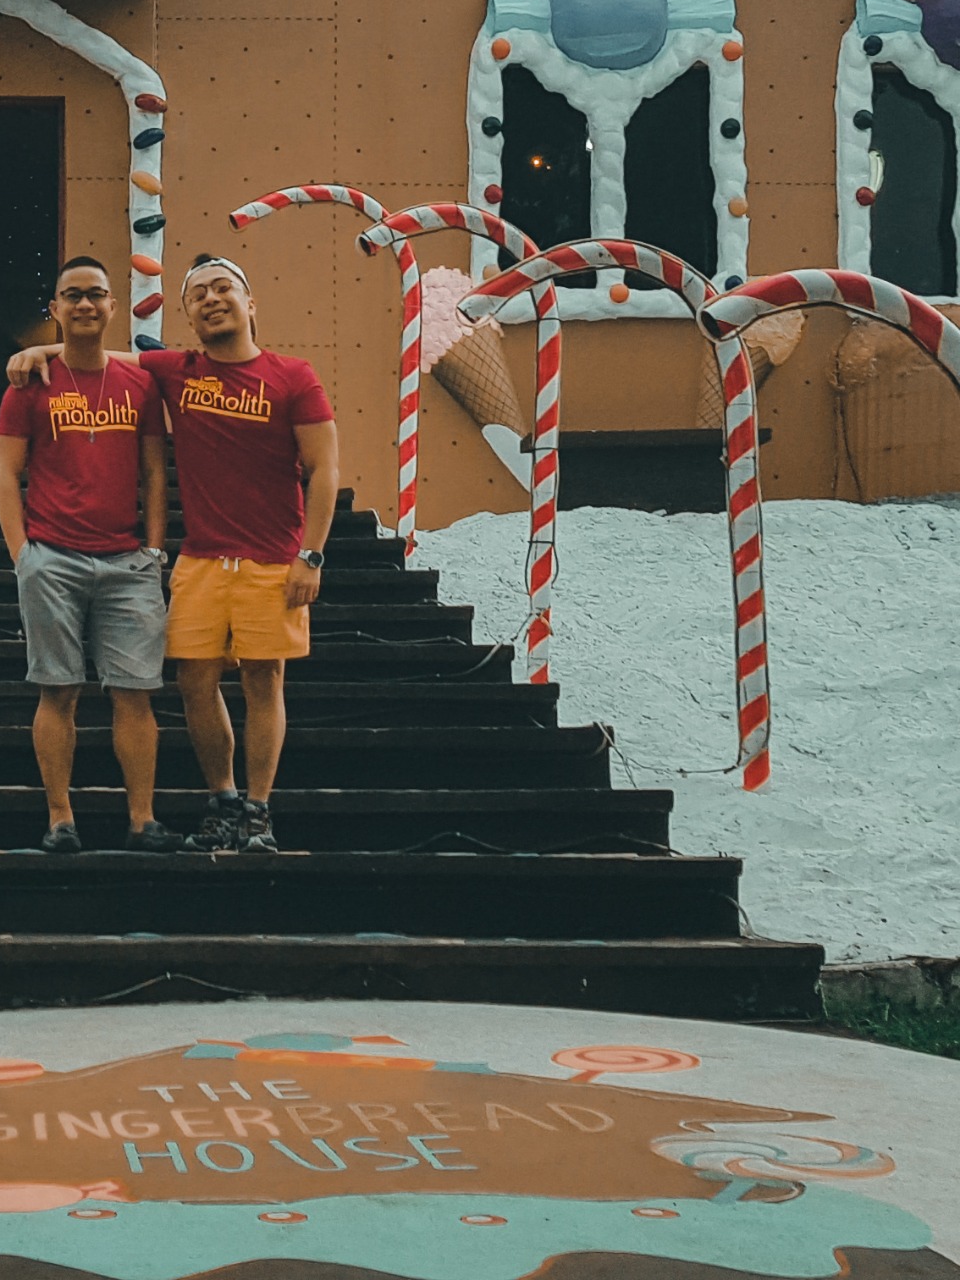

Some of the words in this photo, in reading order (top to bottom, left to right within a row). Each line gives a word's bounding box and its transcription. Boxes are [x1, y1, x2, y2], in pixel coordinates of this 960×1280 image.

[50, 389, 138, 441] monolith
[179, 380, 271, 416] monolith
[138, 1078, 311, 1104] THE
[122, 1133, 478, 1174] HOUSE
